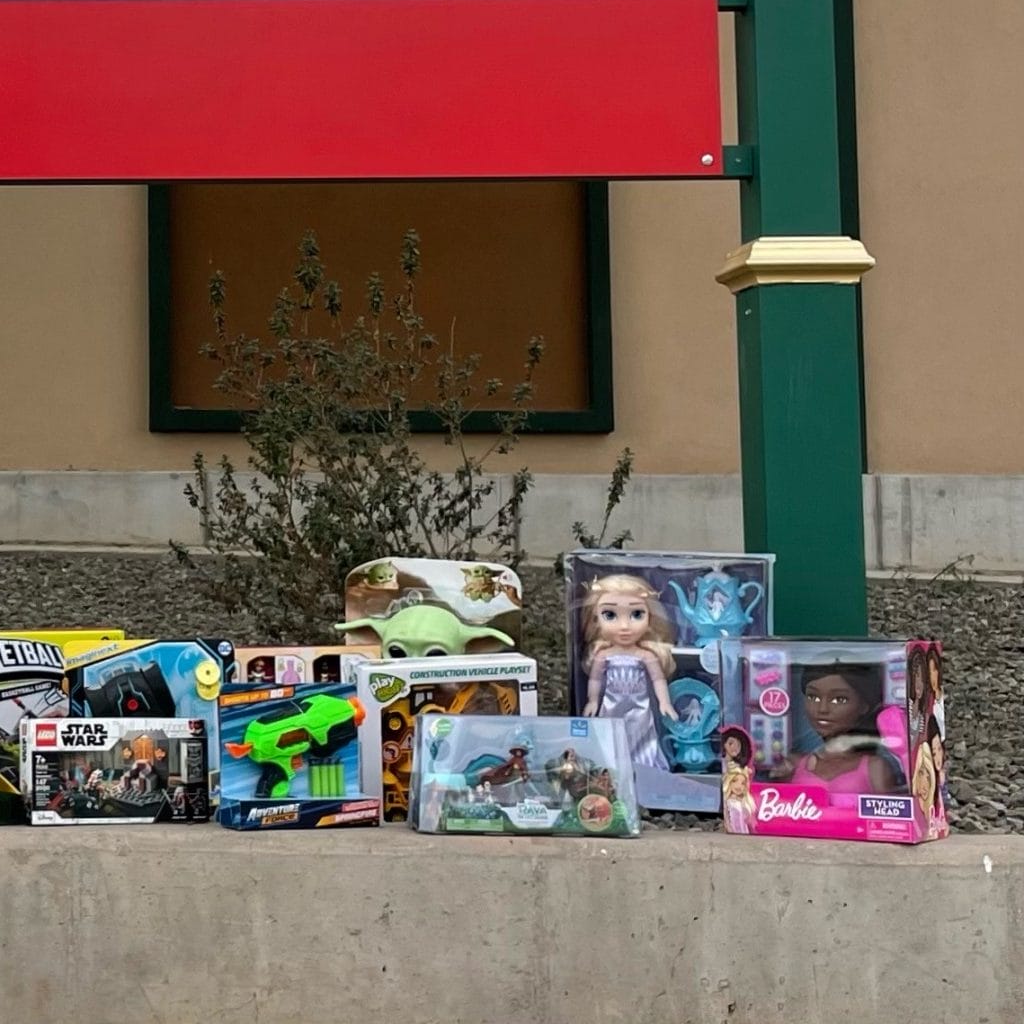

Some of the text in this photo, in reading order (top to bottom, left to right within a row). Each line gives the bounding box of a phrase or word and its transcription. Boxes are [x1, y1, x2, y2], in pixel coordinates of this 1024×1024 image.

[409, 665, 532, 679] CONSTRUCTION VEHICLE PLAYSET
[369, 676, 395, 696] play
[768, 692, 781, 703] 17
[61, 723, 108, 735] STAR
[61, 735, 108, 746] WARS
[757, 788, 824, 822] Barbie
[866, 799, 906, 810] STYLING
[874, 807, 900, 817] HEAD
